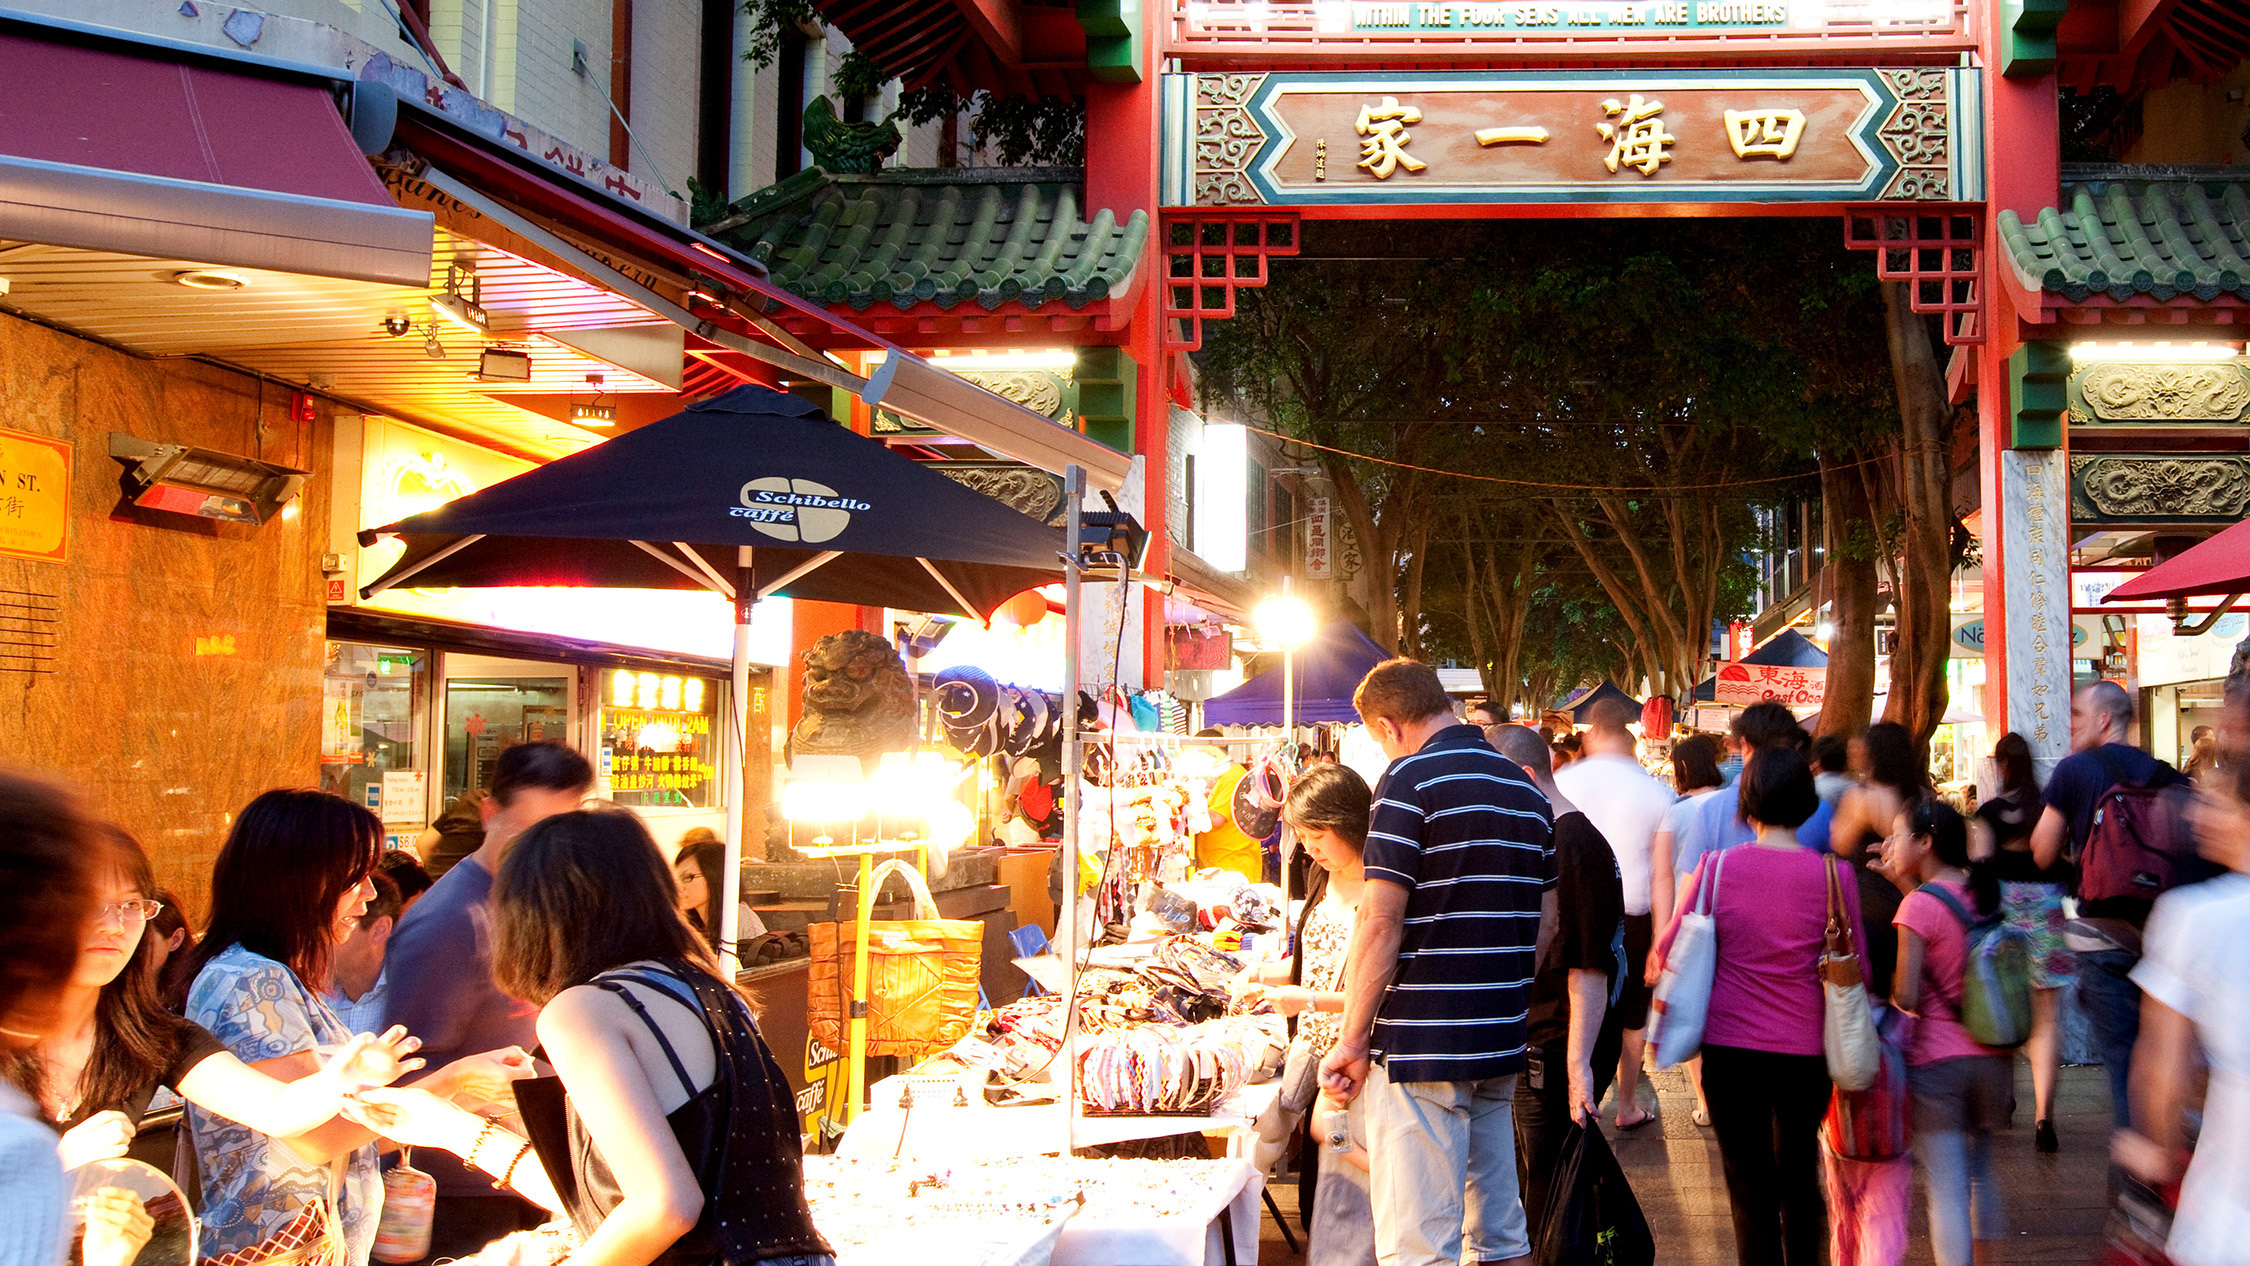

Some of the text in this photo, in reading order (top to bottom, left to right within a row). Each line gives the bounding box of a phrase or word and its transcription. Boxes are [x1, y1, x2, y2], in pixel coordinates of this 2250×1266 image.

[1353, 2, 1786, 28] WITHIN THE FOUR SEAS ALL MEN ARE BROTHERS
[17, 473, 41, 492] ST.
[755, 491, 871, 511] Schibello
[685, 715, 709, 735] 2AM
[398, 835, 421, 849] $6.0
